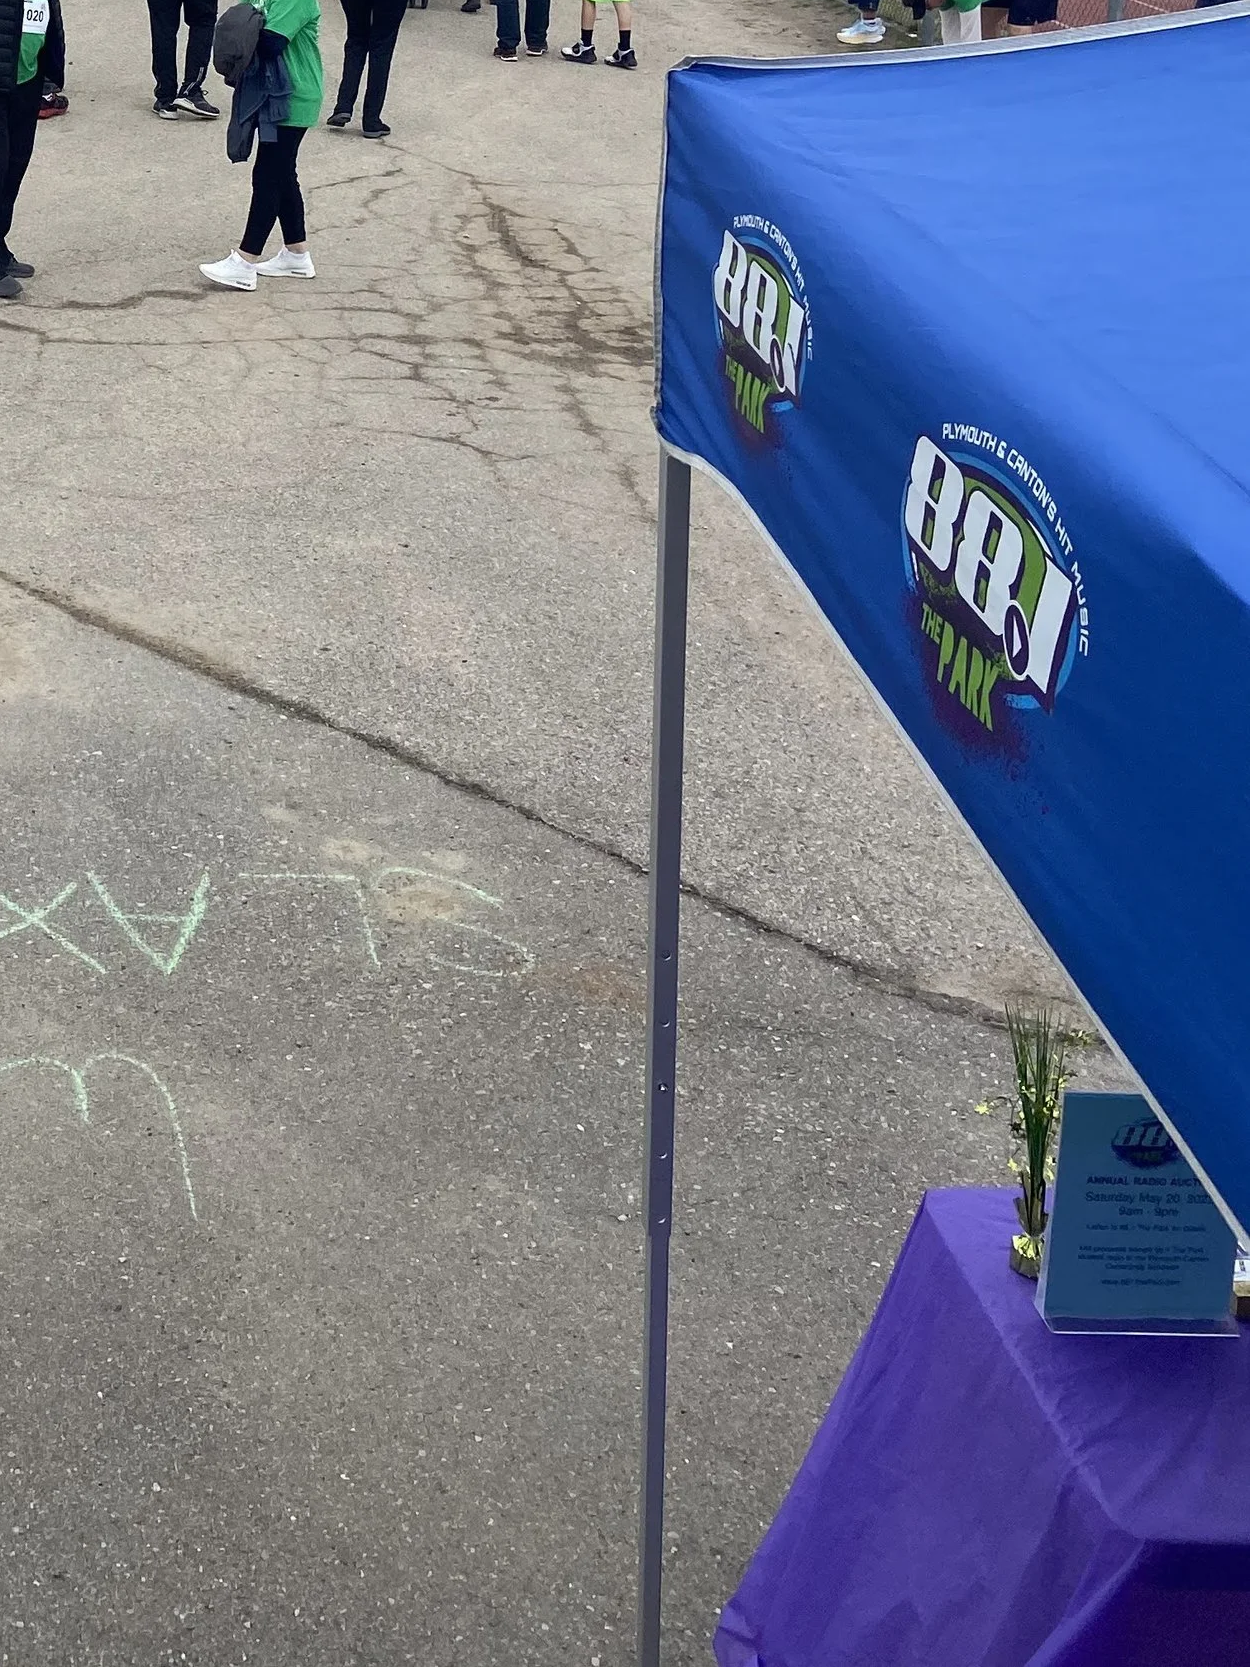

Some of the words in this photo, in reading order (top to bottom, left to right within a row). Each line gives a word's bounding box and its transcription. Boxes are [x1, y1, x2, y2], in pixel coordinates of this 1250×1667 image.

[733, 214, 765, 230] PLYMOUTH
[769, 223, 798, 272] CANTON'S
[795, 266, 805, 292] HIT
[802, 294, 813, 361] MUSIC
[725, 354, 739, 383] THE
[735, 363, 770, 434] PARK
[942, 422, 998, 456] PLYMOUTH
[996, 440, 1007, 460] &
[1006, 448, 1058, 523] CANTON'S
[1054, 520, 1073, 556] HIT
[1070, 560, 1090, 657] MUSIC
[921, 602, 943, 647] THE
[937, 620, 1000, 732] PARK
[1085, 1191, 1135, 1204] Saturday
[1139, 1192, 1162, 1205] May
